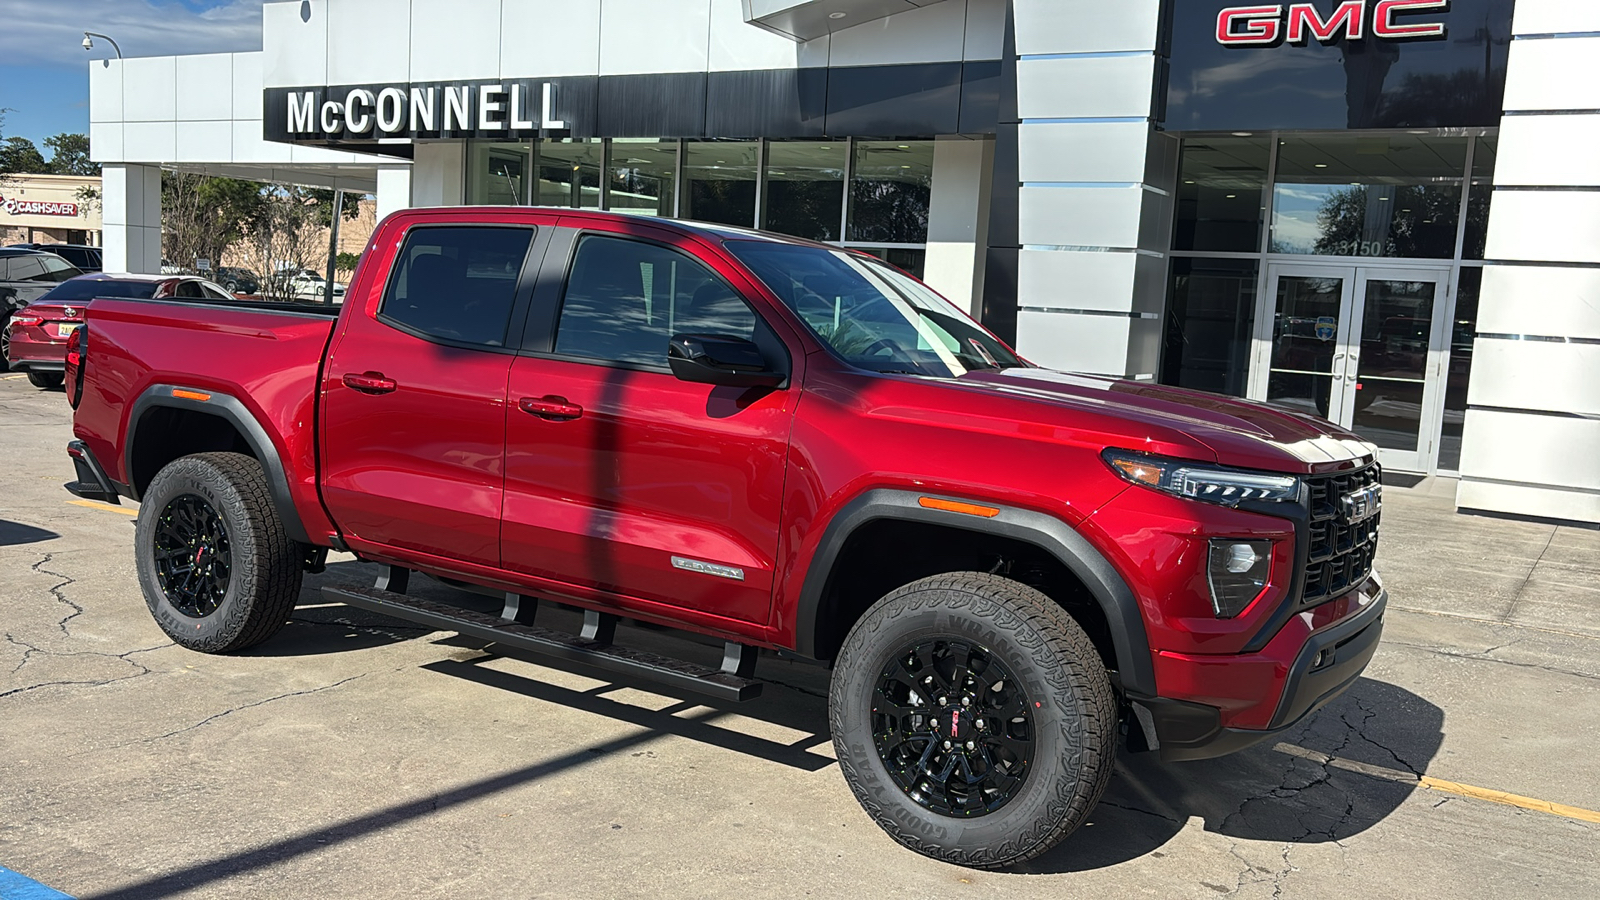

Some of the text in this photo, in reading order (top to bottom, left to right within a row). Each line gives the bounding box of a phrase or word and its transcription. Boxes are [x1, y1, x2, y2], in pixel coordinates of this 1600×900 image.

[1216, 0, 1446, 44] GMC
[287, 82, 564, 134] McCONNELL
[1339, 240, 1381, 256] 3150
[948, 614, 1050, 710] WRANGLER
